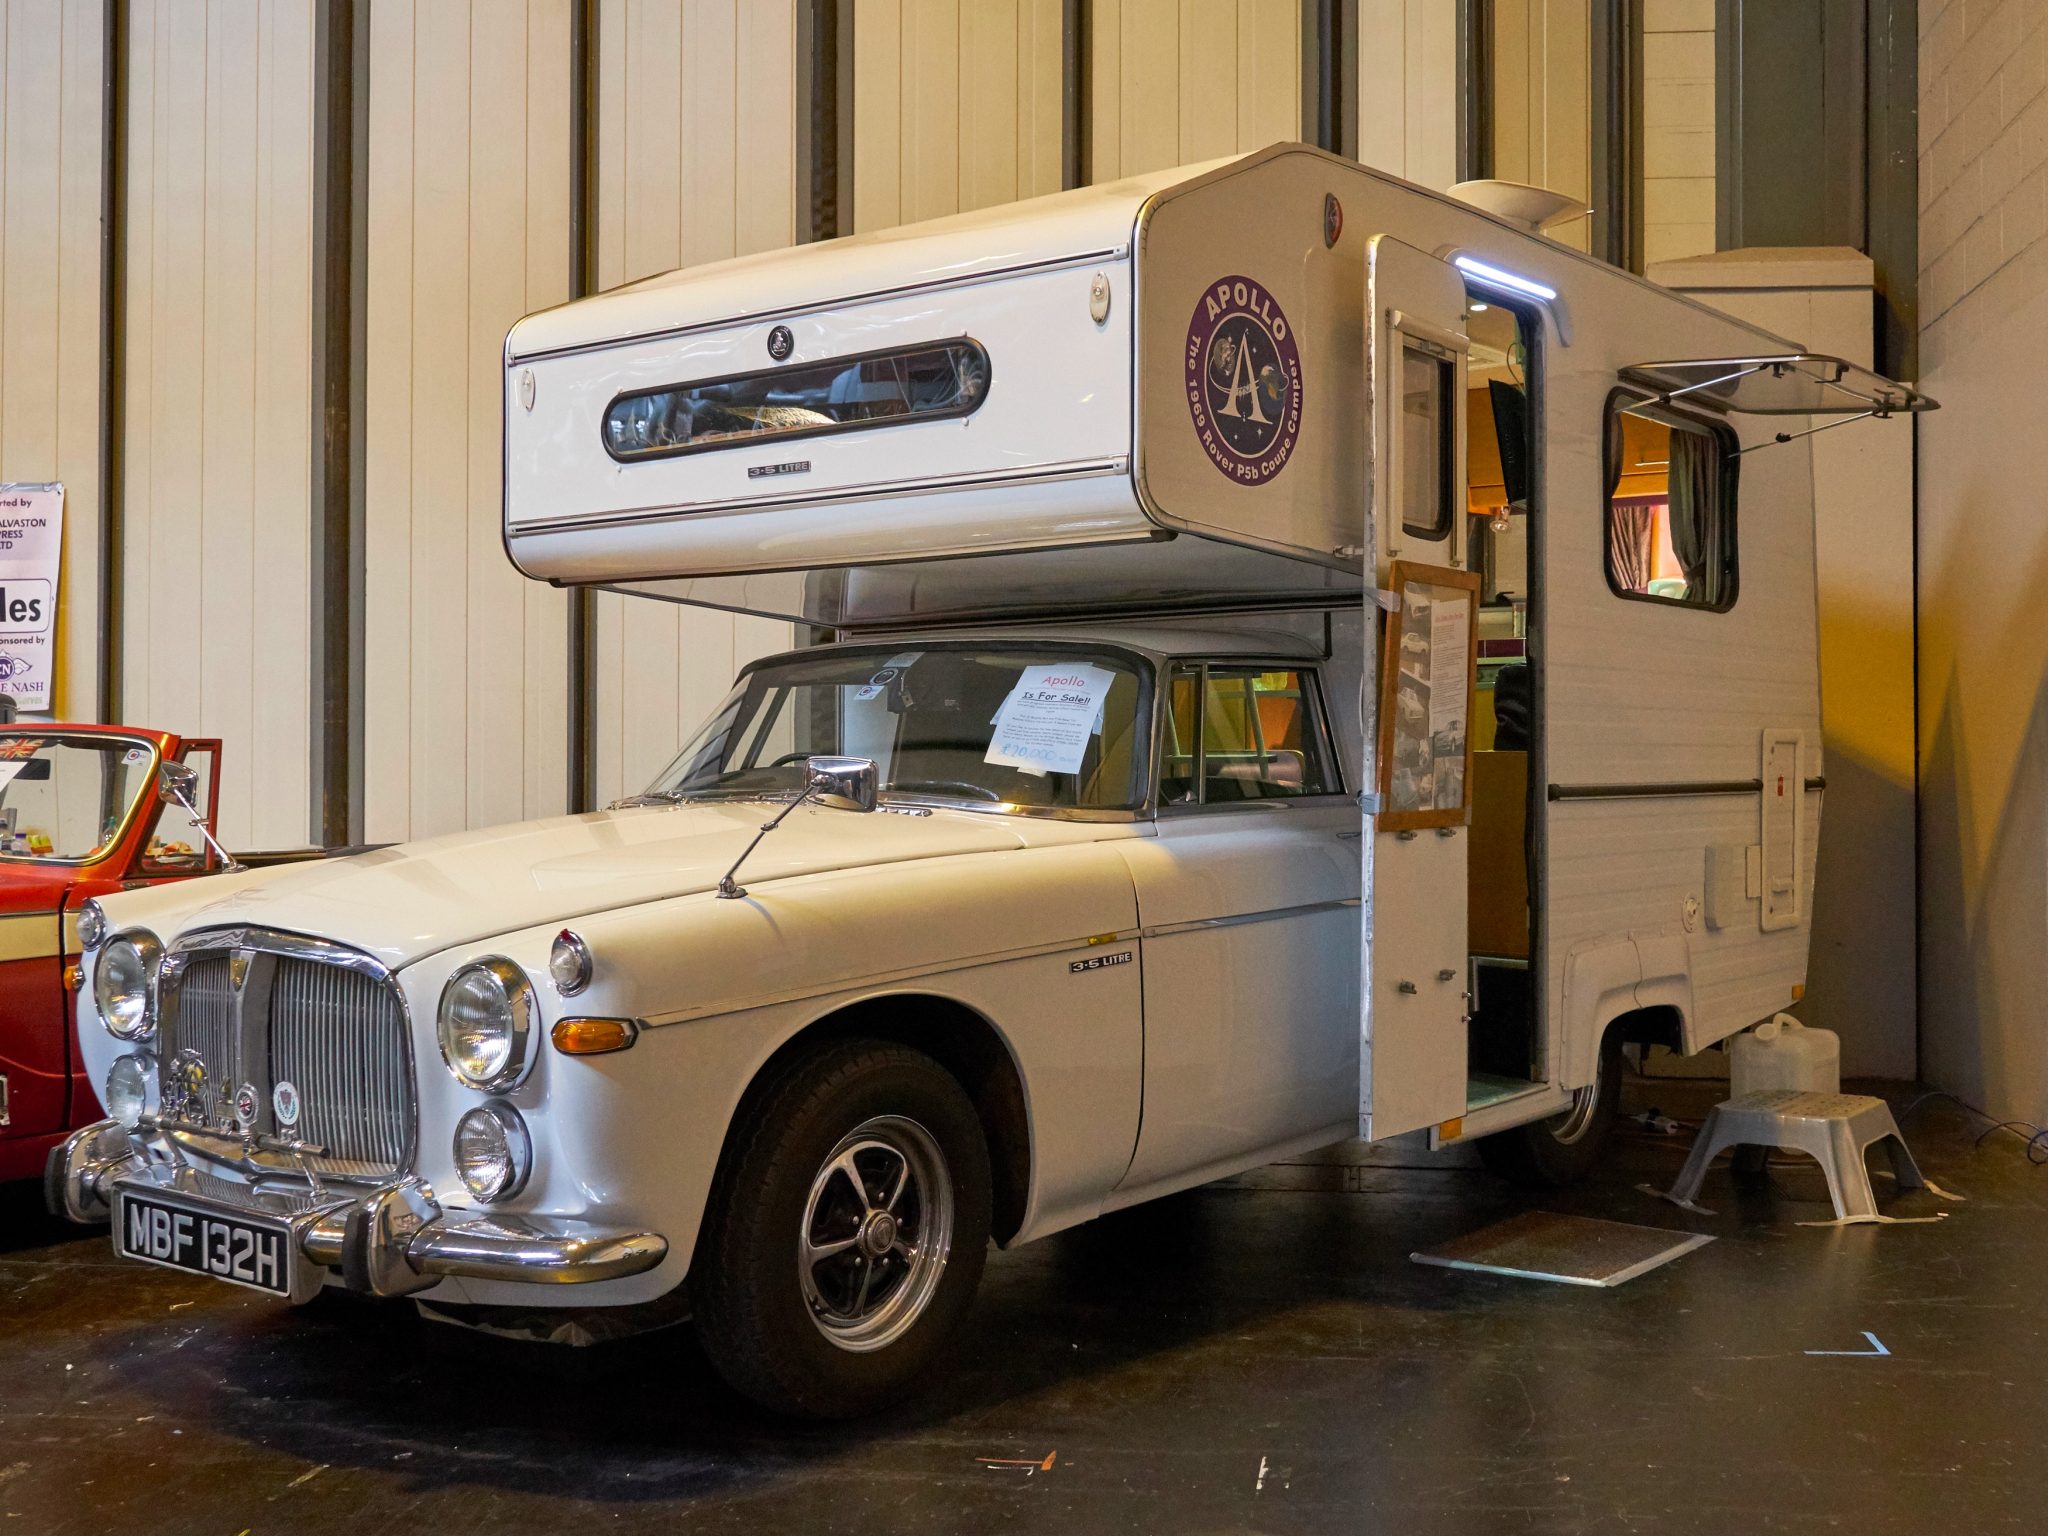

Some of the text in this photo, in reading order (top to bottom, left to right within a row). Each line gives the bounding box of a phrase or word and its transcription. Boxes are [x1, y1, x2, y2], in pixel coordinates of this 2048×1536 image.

[1206, 282, 1286, 341] APOLLO
[1188, 335, 1301, 480] The 1969 Rover P5b Coupe Camper
[779, 462, 808, 473] LITRE
[20, 498, 32, 508] by
[0, 541, 13, 550] TD
[36, 635, 46, 645] by
[12, 681, 44, 692] NASH
[1042, 675, 1085, 687] Apollo
[1022, 691, 1034, 699] Is
[1038, 691, 1057, 700] For
[1103, 952, 1131, 966] LITRE
[130, 1203, 278, 1287] MBF 132H
